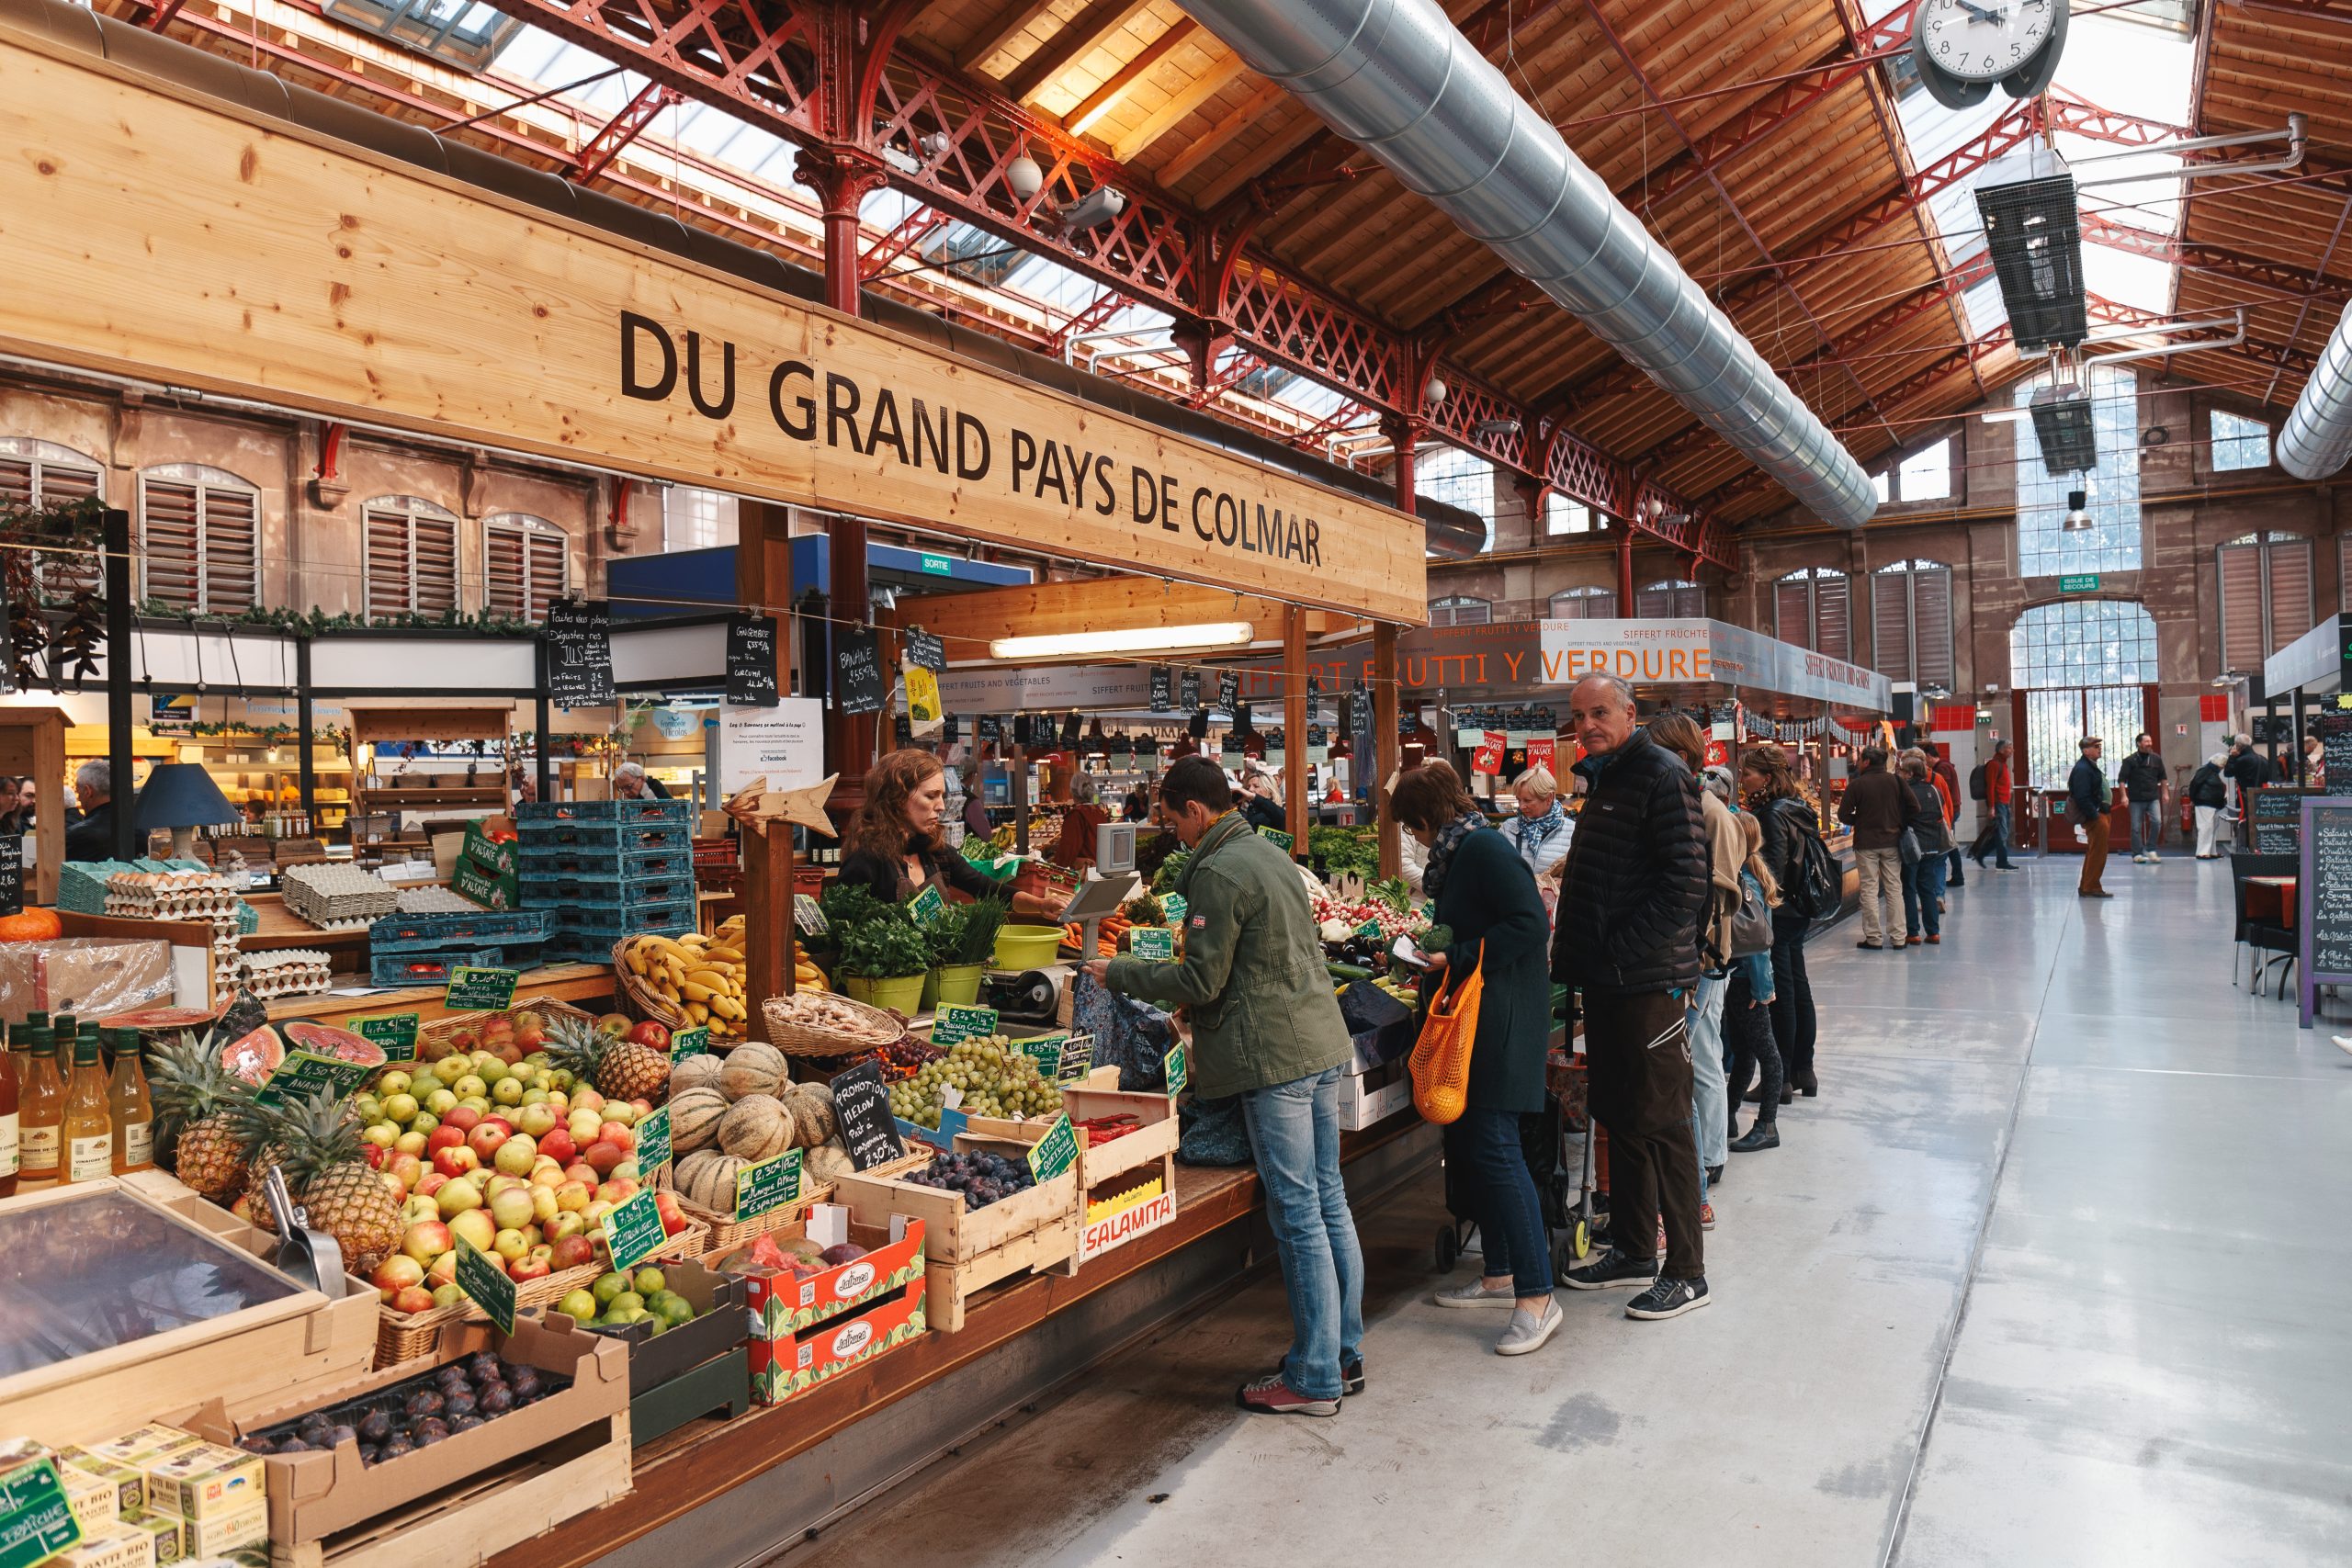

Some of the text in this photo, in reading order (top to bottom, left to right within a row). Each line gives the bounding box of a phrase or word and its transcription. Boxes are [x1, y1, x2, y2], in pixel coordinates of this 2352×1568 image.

[1932, 21, 1943, 34] 9
[2026, 23, 2038, 36] 4
[1940, 41, 1951, 54] 8
[2010, 43, 2020, 57] 5
[1959, 52, 1970, 67] 7
[1984, 55, 1995, 68] 6
[621, 310, 1321, 567] DU GRAND PAYS DE COLMAR
[924, 558, 948, 570] SORTIE
[549, 630, 584, 644] Dégustez
[1432, 626, 1472, 639] SIFFERT
[1476, 625, 1510, 637] FRUTTI
[1512, 624, 1521, 634] Y
[1522, 622, 1570, 634] VERDURE
[1623, 629, 1662, 639] SIFFERT
[561, 645, 583, 664] JUS
[840, 647, 873, 669] BANANE
[1503, 651, 1525, 682] Y
[1540, 649, 1711, 682] VERDURE
[1805, 654, 1825, 678] SIFFERT
[938, 677, 1051, 690] FFERT FRUITS AND VEGETABLES
[1092, 685, 1124, 694] SIFFERT
[1125, 683, 1150, 694] FRUIT
[1528, 748, 1552, 756] D'ALSACE
[2323, 827, 2348, 838] Salade
[470, 841, 496, 862] D'ALSACE
[2325, 855, 2349, 863] Salade
[460, 877, 488, 898] D'ALSACE
[2326, 890, 2350, 902] Soupe
[944, 1021, 991, 1033] Raisin Crimson
[288, 1078, 322, 1091] ANANA
[844, 1096, 875, 1124] MELON
[1044, 1136, 1071, 1171] QUETSCHE
[755, 1161, 781, 1181] 2,30€
[750, 1194, 785, 1213] Espagne
[1086, 1195, 1170, 1251] SALAMITA
[150, 1476, 177, 1492] ATTE BIO
[90, 1490, 112, 1505] BIO
[127, 1541, 149, 1555] BIO
